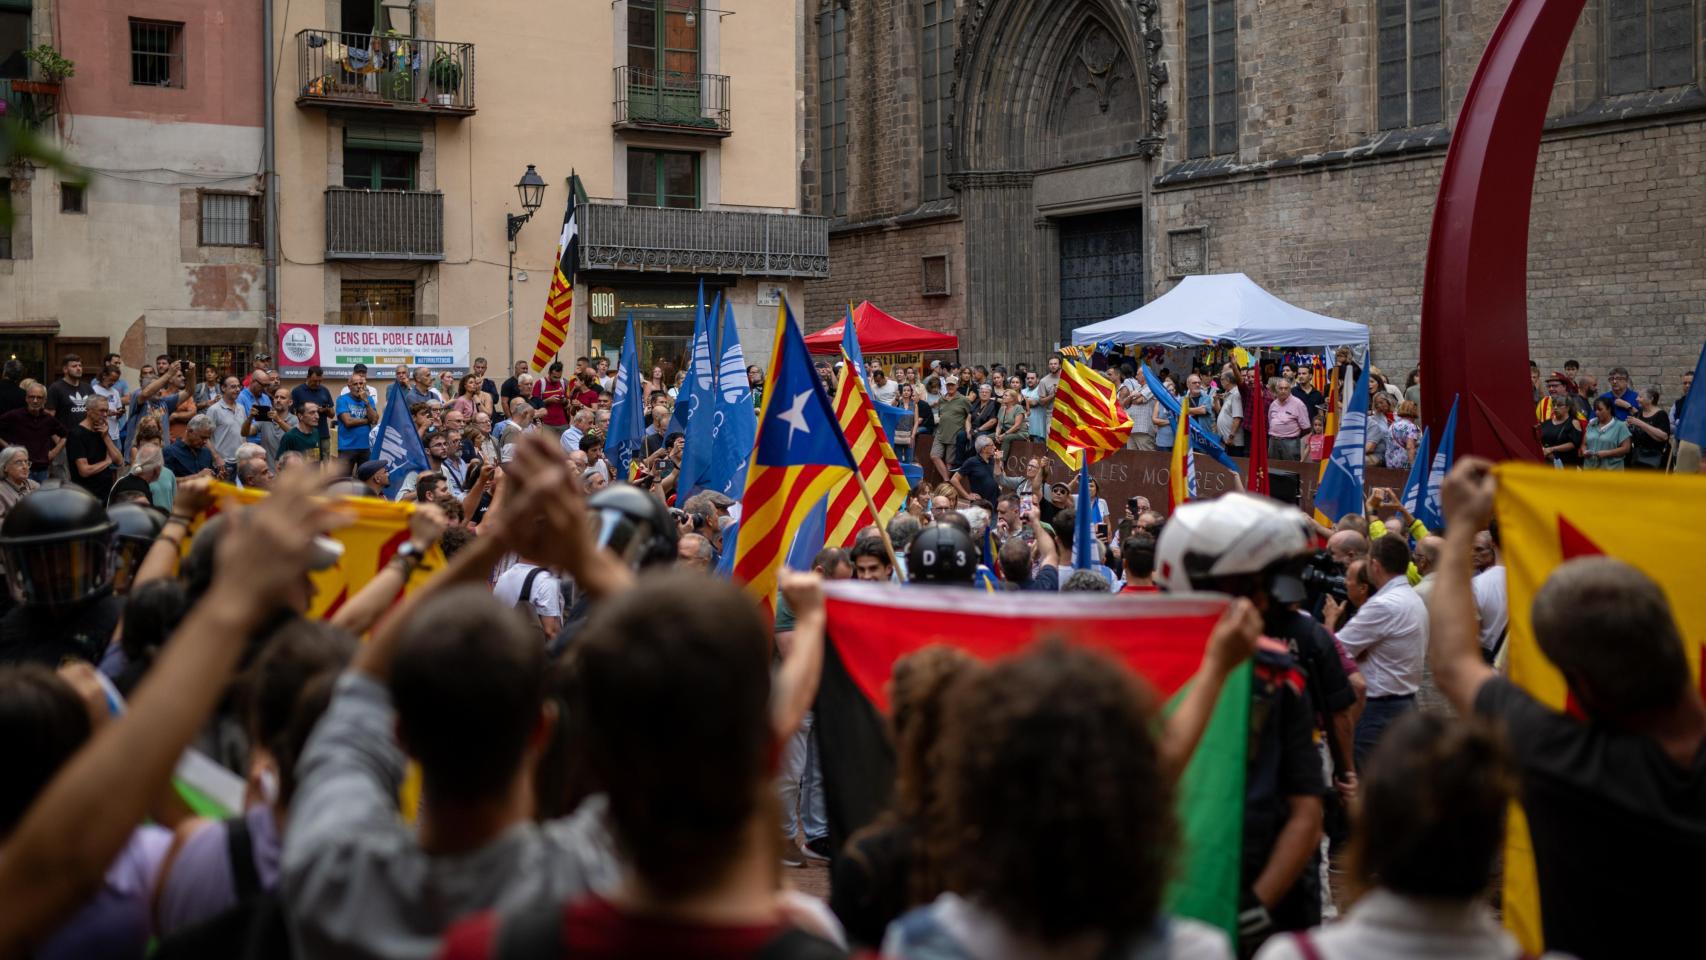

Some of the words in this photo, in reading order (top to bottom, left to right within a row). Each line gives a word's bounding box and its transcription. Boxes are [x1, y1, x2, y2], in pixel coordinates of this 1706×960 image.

[591, 292, 615, 317] BIBA
[334, 331, 360, 345] CENS
[362, 332, 380, 345] DEL
[382, 333, 413, 346] POBLE
[415, 330, 454, 346] CATALÀ
[1142, 465, 1226, 491] MORES
[923, 550, 936, 566] D
[956, 550, 967, 567] 3
